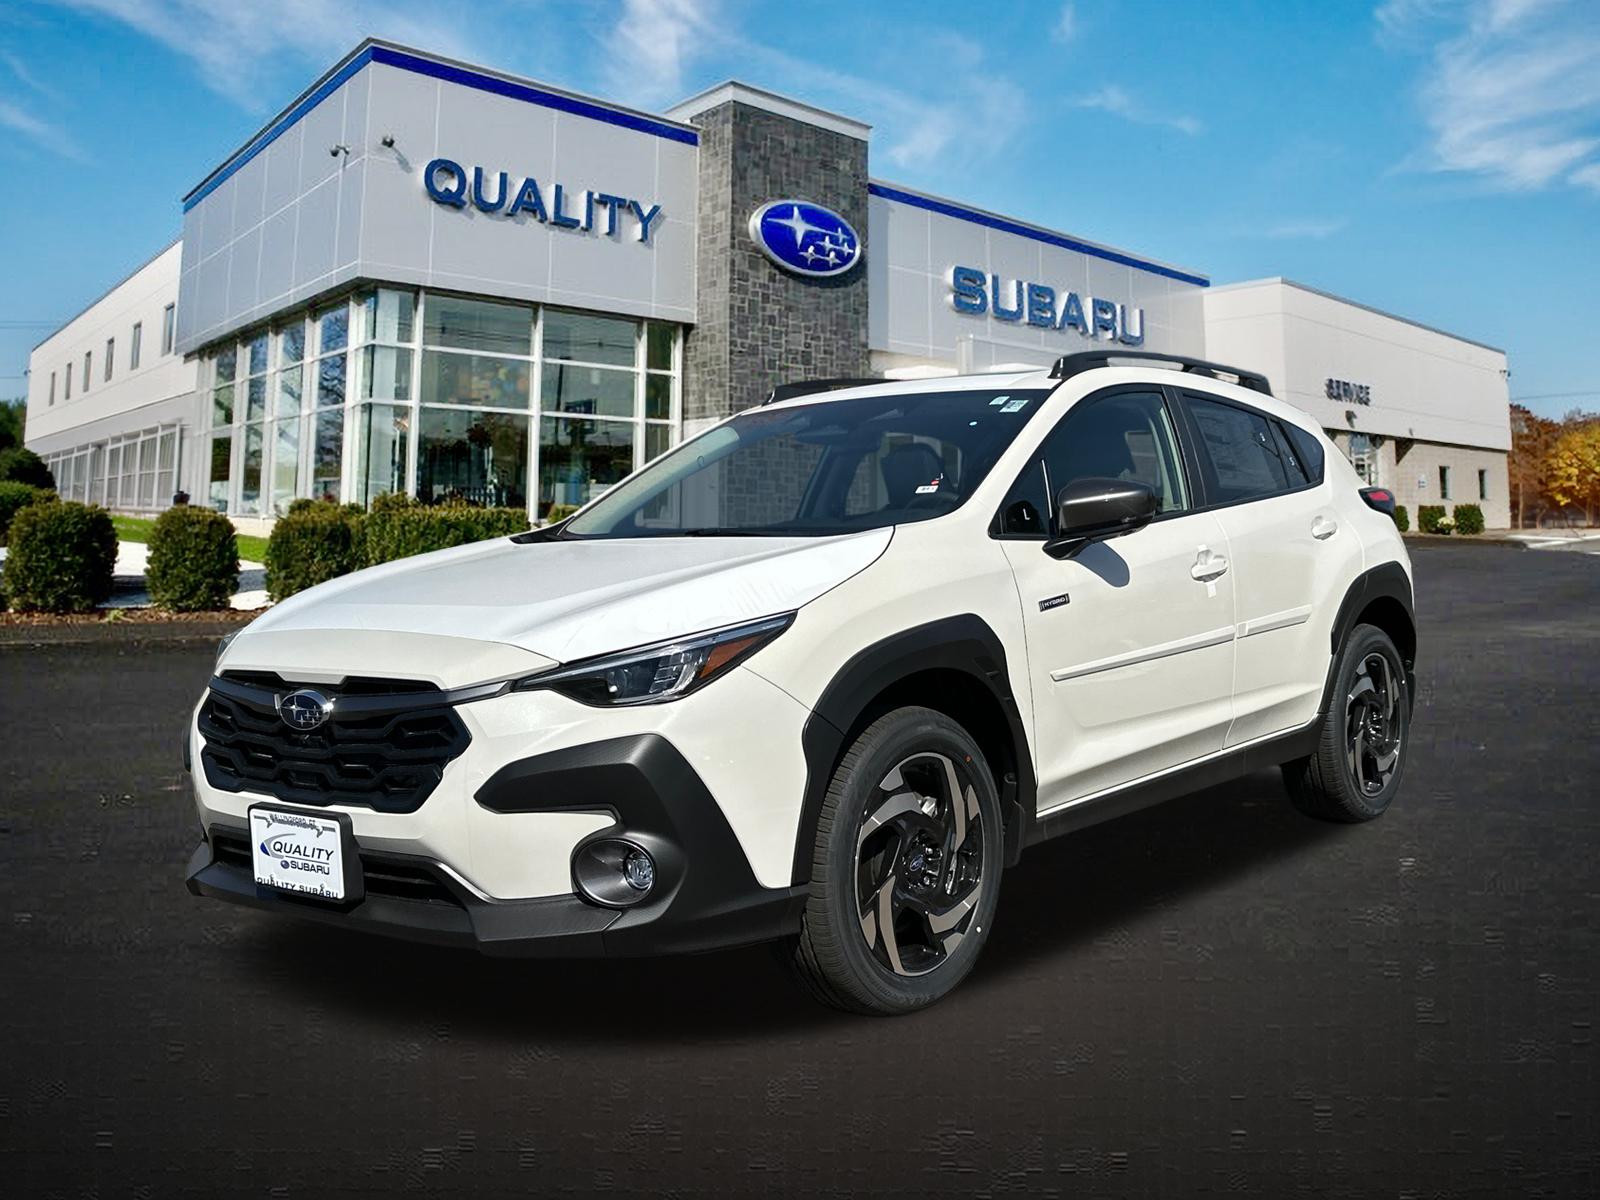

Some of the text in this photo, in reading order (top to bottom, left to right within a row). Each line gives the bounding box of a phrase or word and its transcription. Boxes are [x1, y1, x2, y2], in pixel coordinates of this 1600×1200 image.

[424, 158, 661, 242] QUALITY
[950, 265, 1145, 347] SUBARU
[1325, 377, 1371, 406] SERVICE
[272, 841, 334, 861] QUALITY
[289, 860, 330, 876] SUBARU
[256, 876, 339, 899] QUALITY SUBARU
